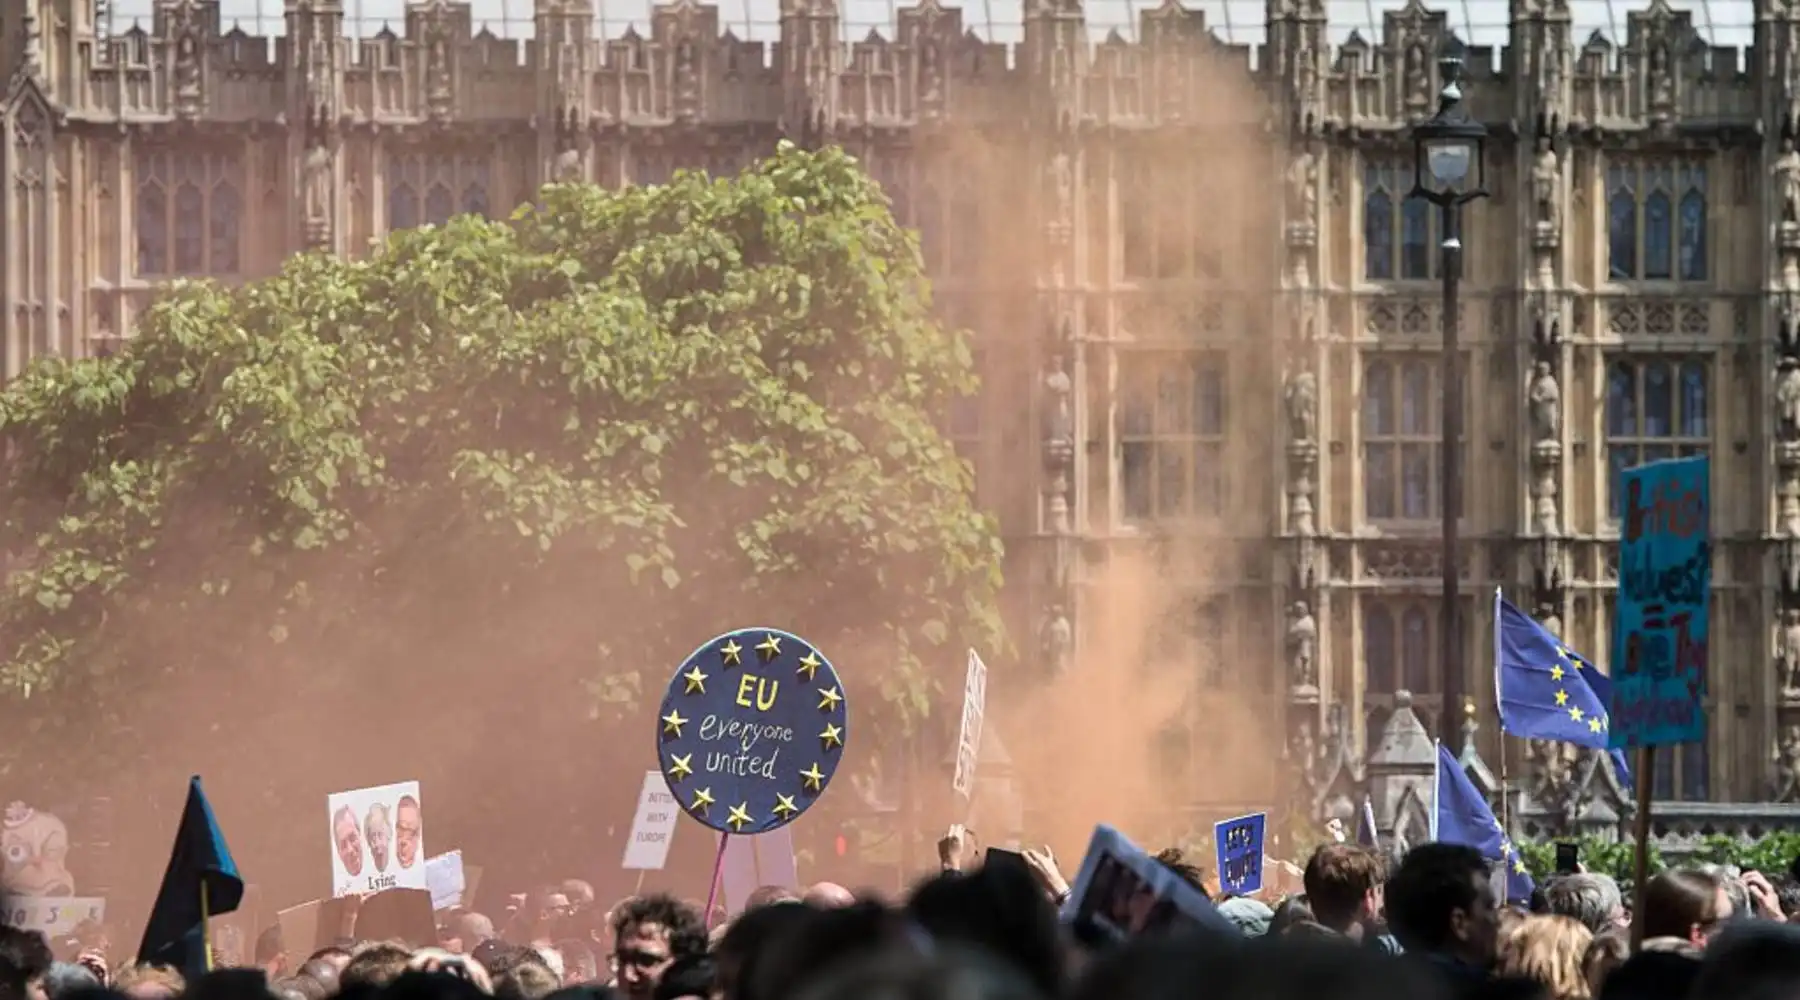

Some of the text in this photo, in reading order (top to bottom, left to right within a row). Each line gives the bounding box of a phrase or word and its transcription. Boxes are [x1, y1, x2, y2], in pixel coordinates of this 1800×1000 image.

[736, 673, 779, 711] EU
[699, 714, 793, 751] everyone
[706, 748, 778, 779] united
